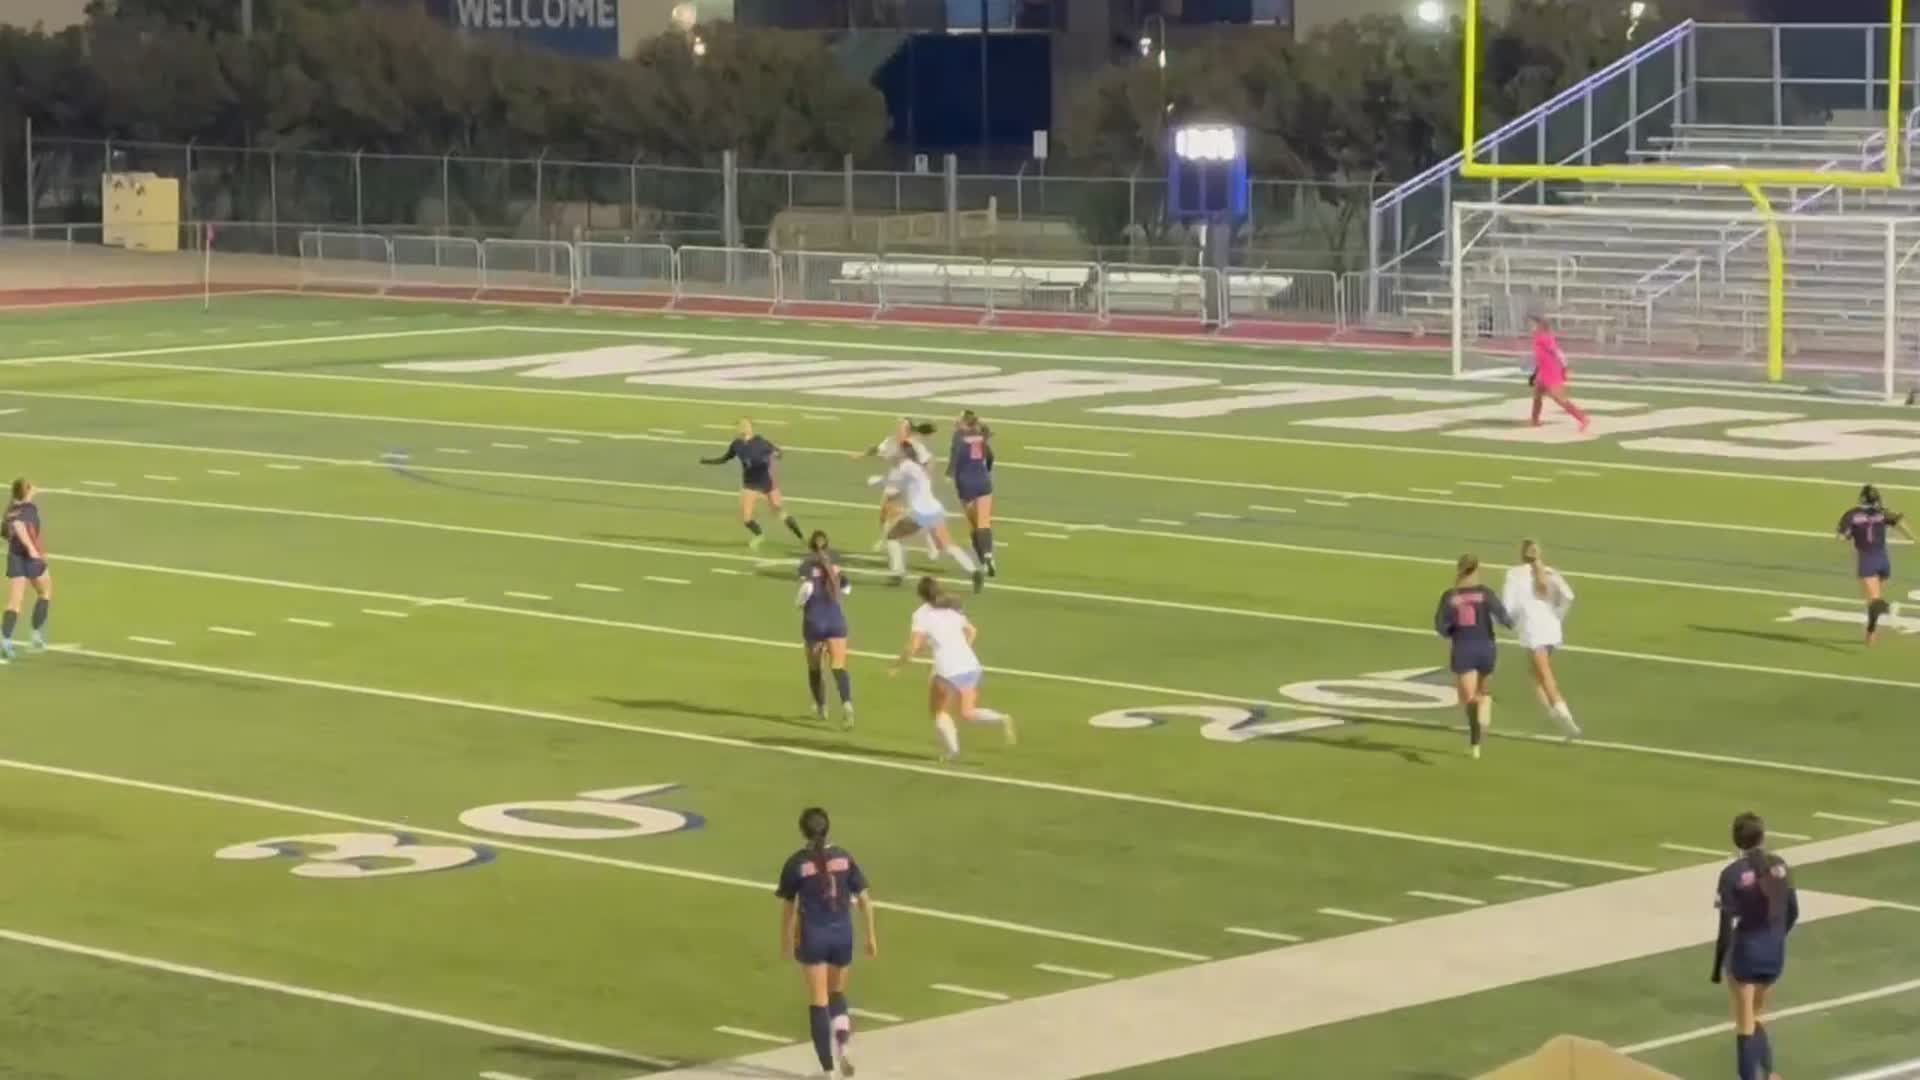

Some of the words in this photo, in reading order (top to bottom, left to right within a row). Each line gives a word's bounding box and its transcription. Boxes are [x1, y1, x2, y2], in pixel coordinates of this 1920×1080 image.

[457, 0, 616, 28] WELCOME
[1088, 679, 1460, 743] 20
[214, 800, 688, 879] 30
